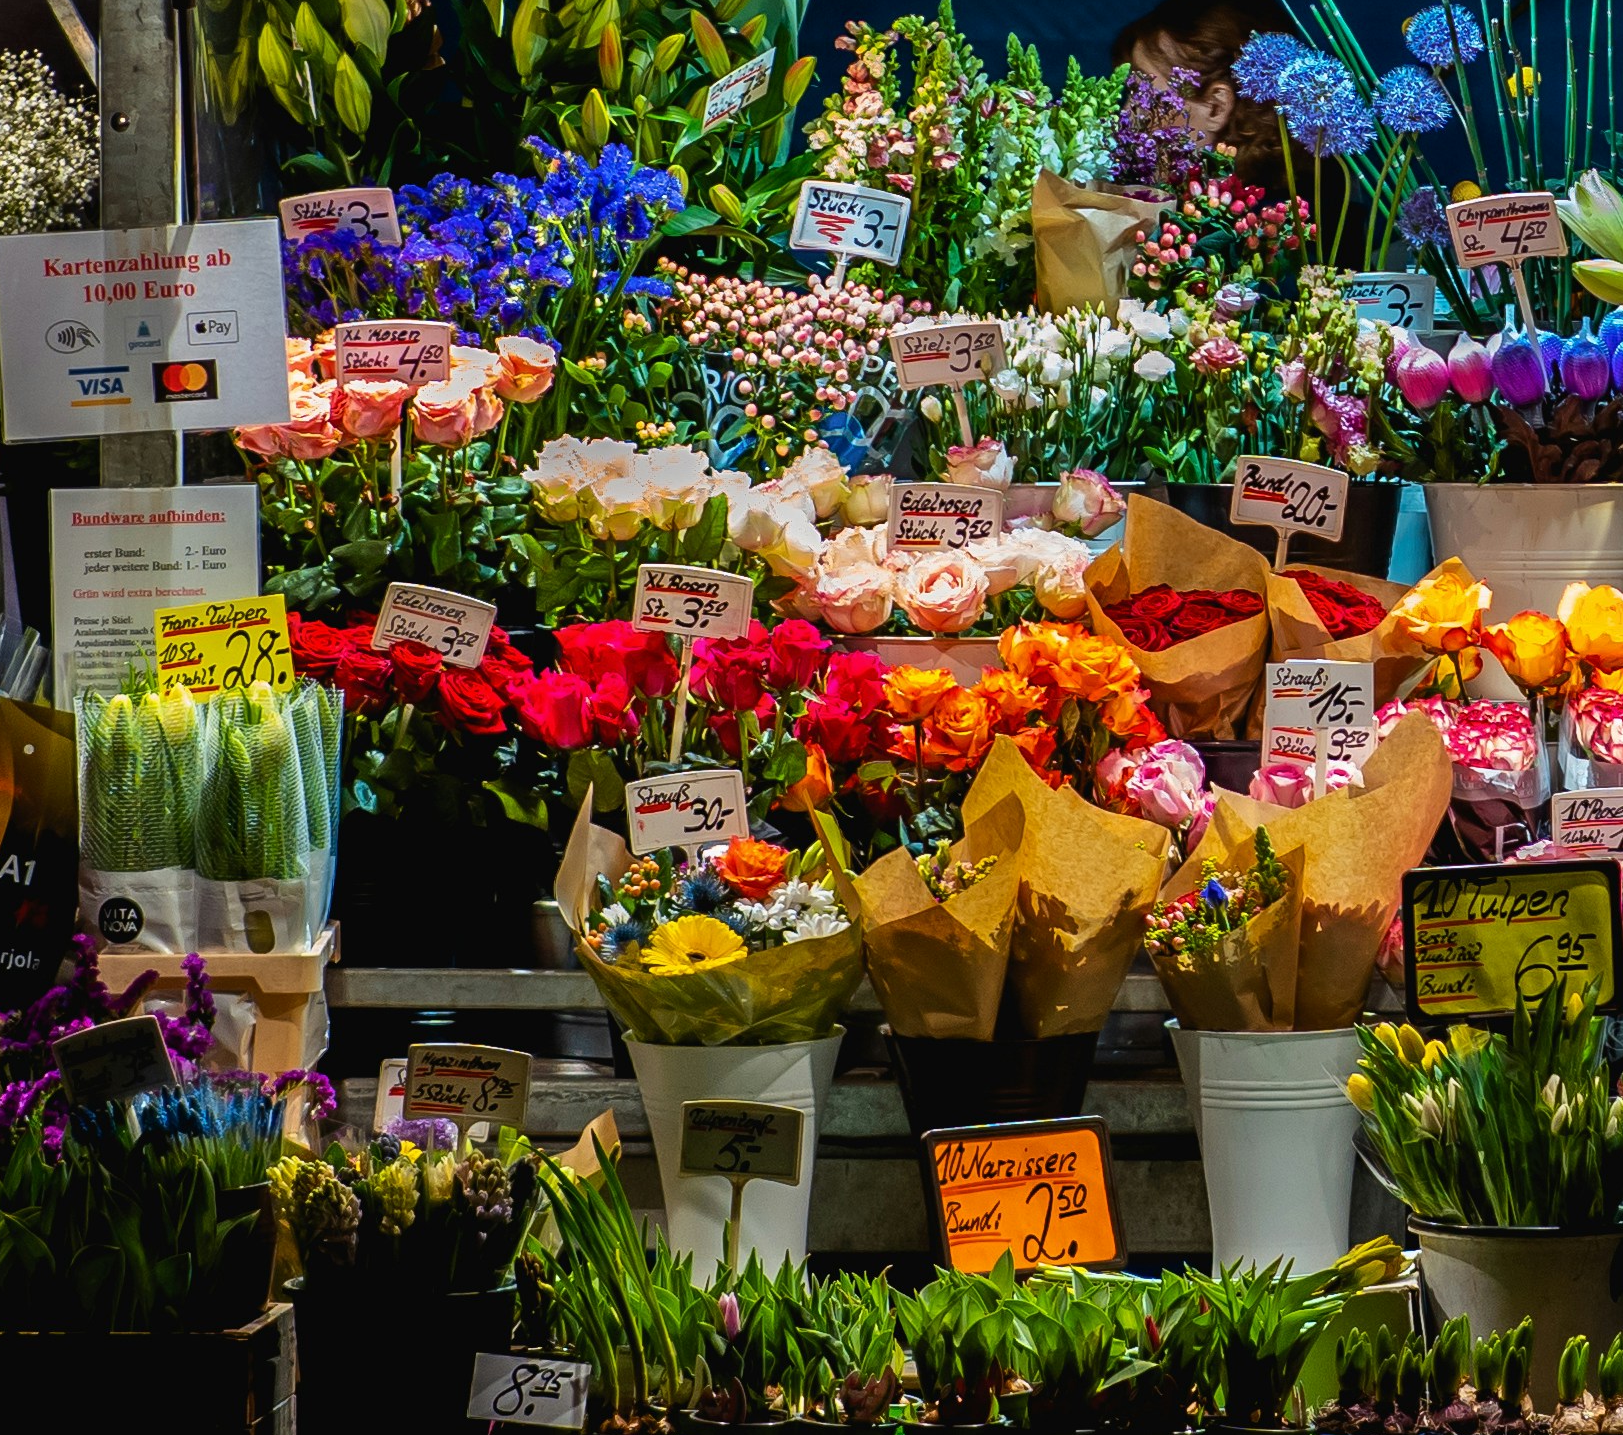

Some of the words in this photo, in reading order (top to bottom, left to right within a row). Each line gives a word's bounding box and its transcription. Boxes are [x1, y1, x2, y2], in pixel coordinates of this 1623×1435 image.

[43, 252, 199, 277] Kartenzahlung
[206, 249, 231, 266] ab
[83, 283, 136, 305] 10,00
[144, 280, 195, 299] Euro
[208, 320, 231, 335] Pay
[343, 329, 361, 341] XL
[77, 378, 124, 396] VISA
[900, 490, 982, 515] Edelrosen
[72, 512, 145, 525] Bundware
[149, 510, 226, 523] aufbinden:
[84, 550, 112, 558] erster
[115, 548, 145, 558] Bund:
[202, 546, 226, 556] Euro
[84, 563, 109, 574] jeder
[113, 563, 149, 572] weitere
[152, 561, 182, 571] Bund:
[202, 560, 226, 570] Euro
[73, 588, 99, 598] Grün
[102, 588, 124, 597] wird
[127, 588, 152, 597] extra
[156, 587, 206, 597] berechnet.
[644, 570, 666, 589] XL
[667, 575, 719, 597] Rosen
[206, 604, 267, 629] Tulpen
[393, 589, 467, 623] Edelrosen
[1414, 879, 1462, 921] 10
[1462, 877, 1569, 926] Tulpen
[104, 908, 138, 920] VITA
[104, 921, 138, 933] NOVA
[1419, 973, 1475, 997] Bund:
[961, 1141, 1078, 1180] Narzissen
